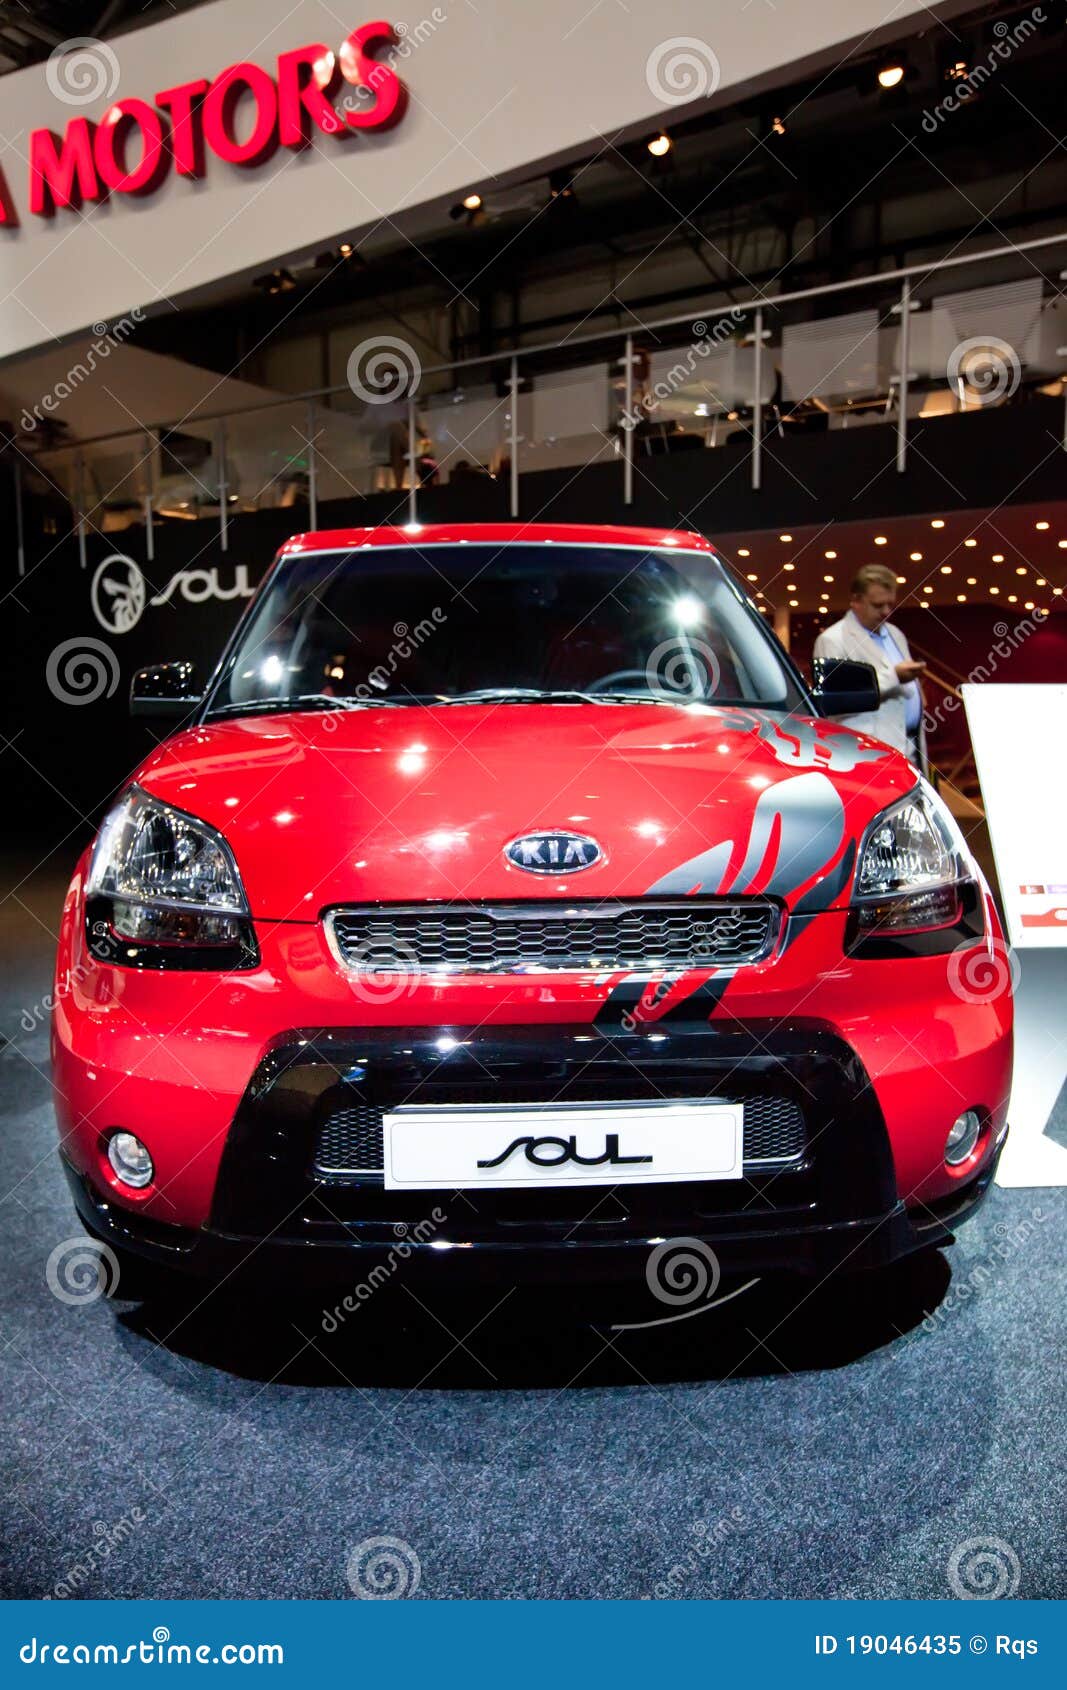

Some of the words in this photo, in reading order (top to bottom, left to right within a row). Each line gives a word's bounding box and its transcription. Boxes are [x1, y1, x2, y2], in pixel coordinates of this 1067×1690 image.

[30, 21, 408, 215] MOTORS
[520, 839, 588, 864] KIA
[476, 1133, 654, 1168] SOUL
